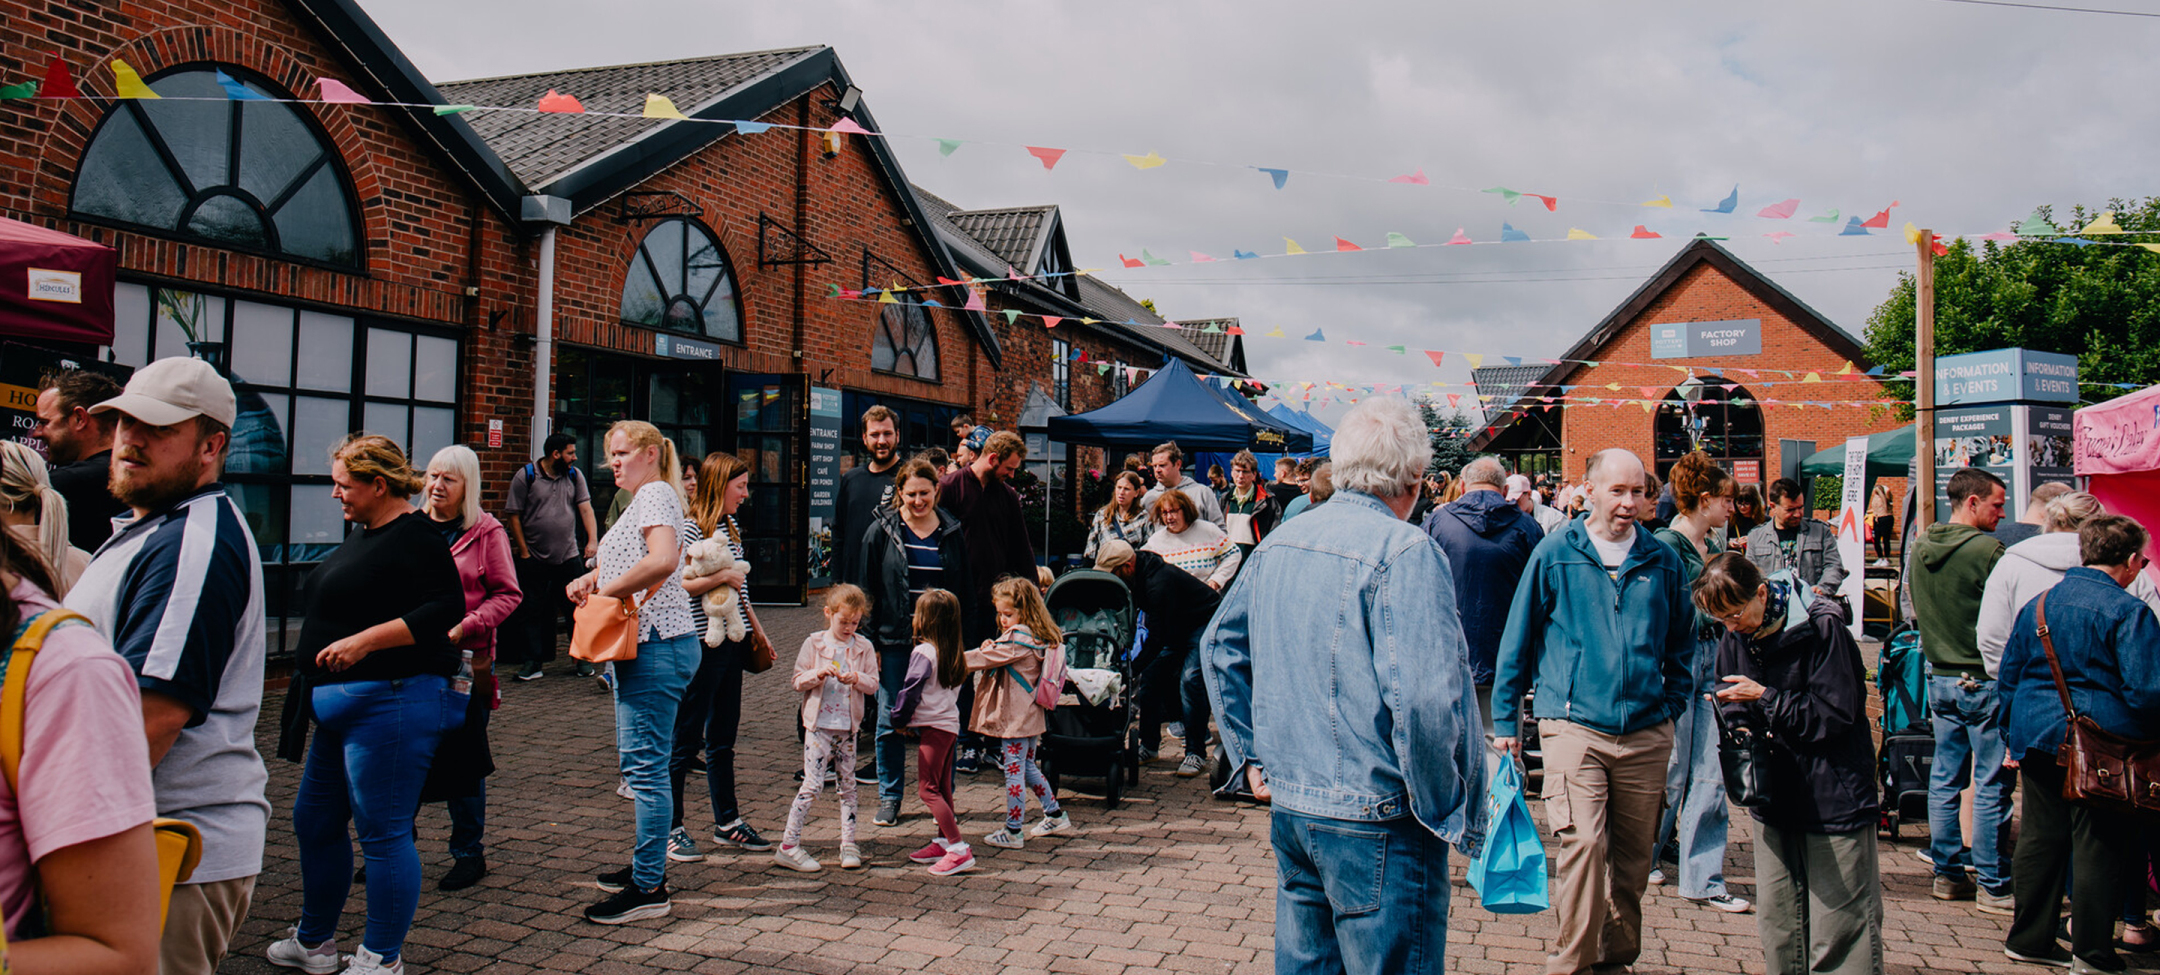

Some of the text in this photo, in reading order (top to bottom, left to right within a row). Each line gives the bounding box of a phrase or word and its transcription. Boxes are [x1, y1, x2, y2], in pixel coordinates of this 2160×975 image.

[1701, 329, 1746, 339] FACTORY
[1710, 338, 1737, 347] SHOP
[676, 343, 713, 359] ENTRANCE
[1935, 361, 2009, 380] NFORMATION
[2026, 361, 2076, 377] INFORMATION
[1943, 380, 1998, 396] & EVENTS
[2041, 379, 2070, 393] EVENTS
[9, 390, 38, 407] HO
[1939, 413, 1999, 424] DENBY EXPERIENCE
[2048, 413, 2062, 421] DENBY
[1952, 423, 1985, 432] PACKAGES
[2039, 421, 2071, 430] GIFT VOUCHERS
[810, 427, 838, 438] ENTRANCE
[811, 441, 835, 450] FARM SHOP
